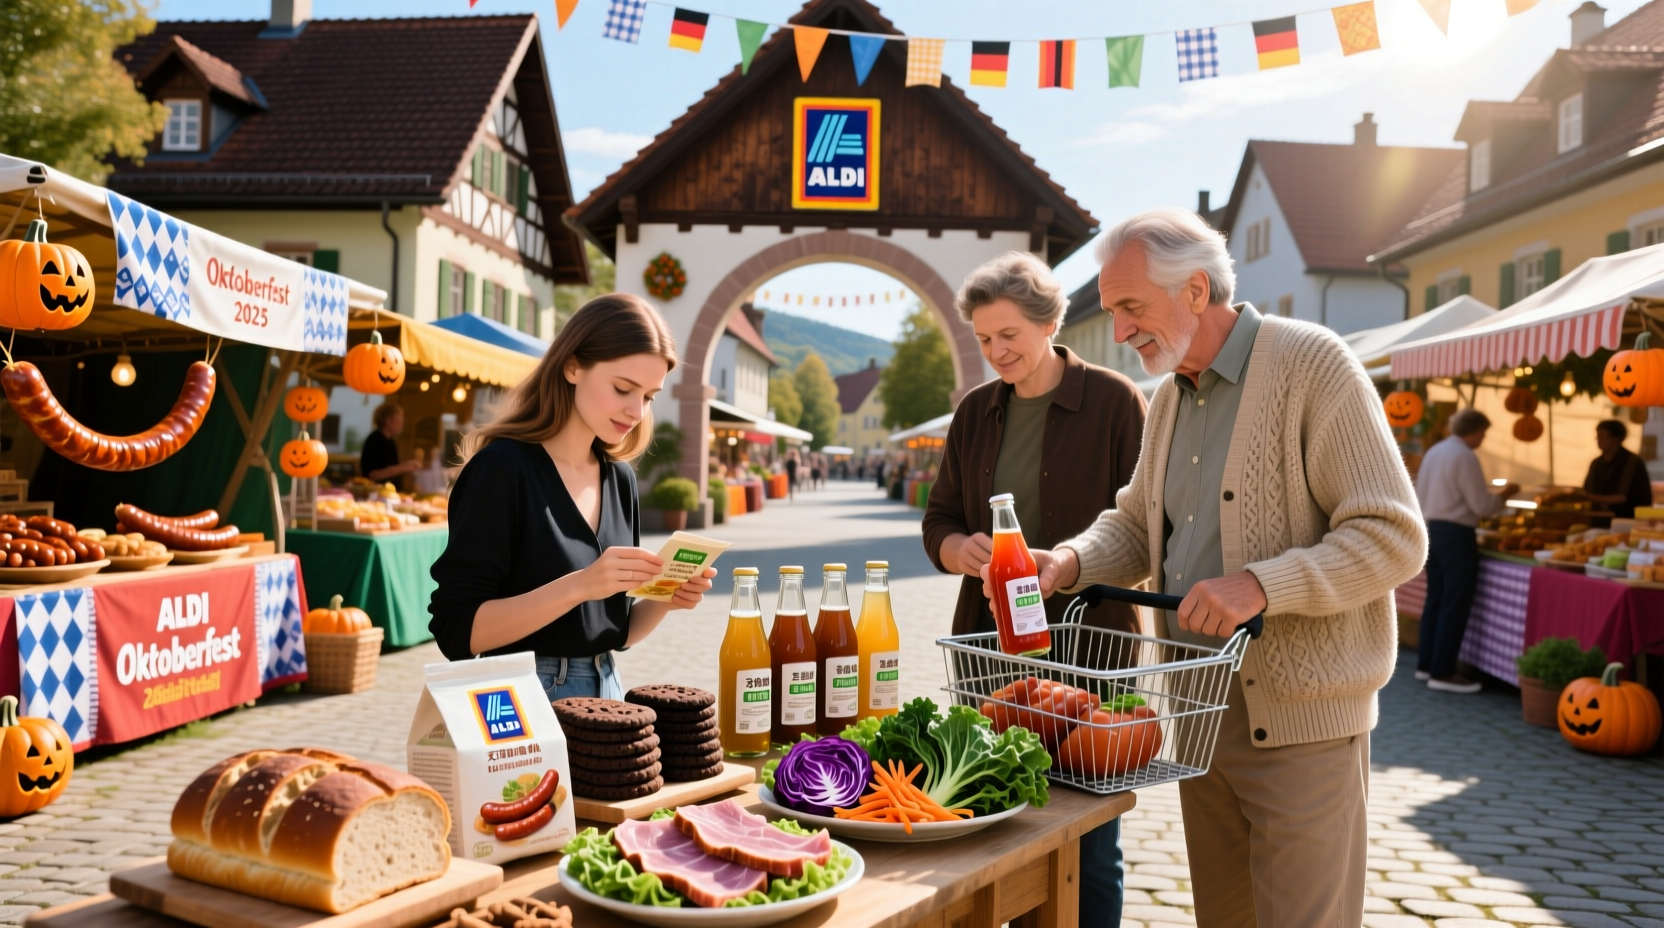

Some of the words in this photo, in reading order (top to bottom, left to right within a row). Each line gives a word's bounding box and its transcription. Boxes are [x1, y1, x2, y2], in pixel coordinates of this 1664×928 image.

[807, 166, 865, 188] ALDI
[206, 257, 290, 306] Oktoberfest
[234, 301, 268, 327] 2025
[156, 591, 209, 632] ALDI
[116, 626, 241, 686] Oktoberfest
